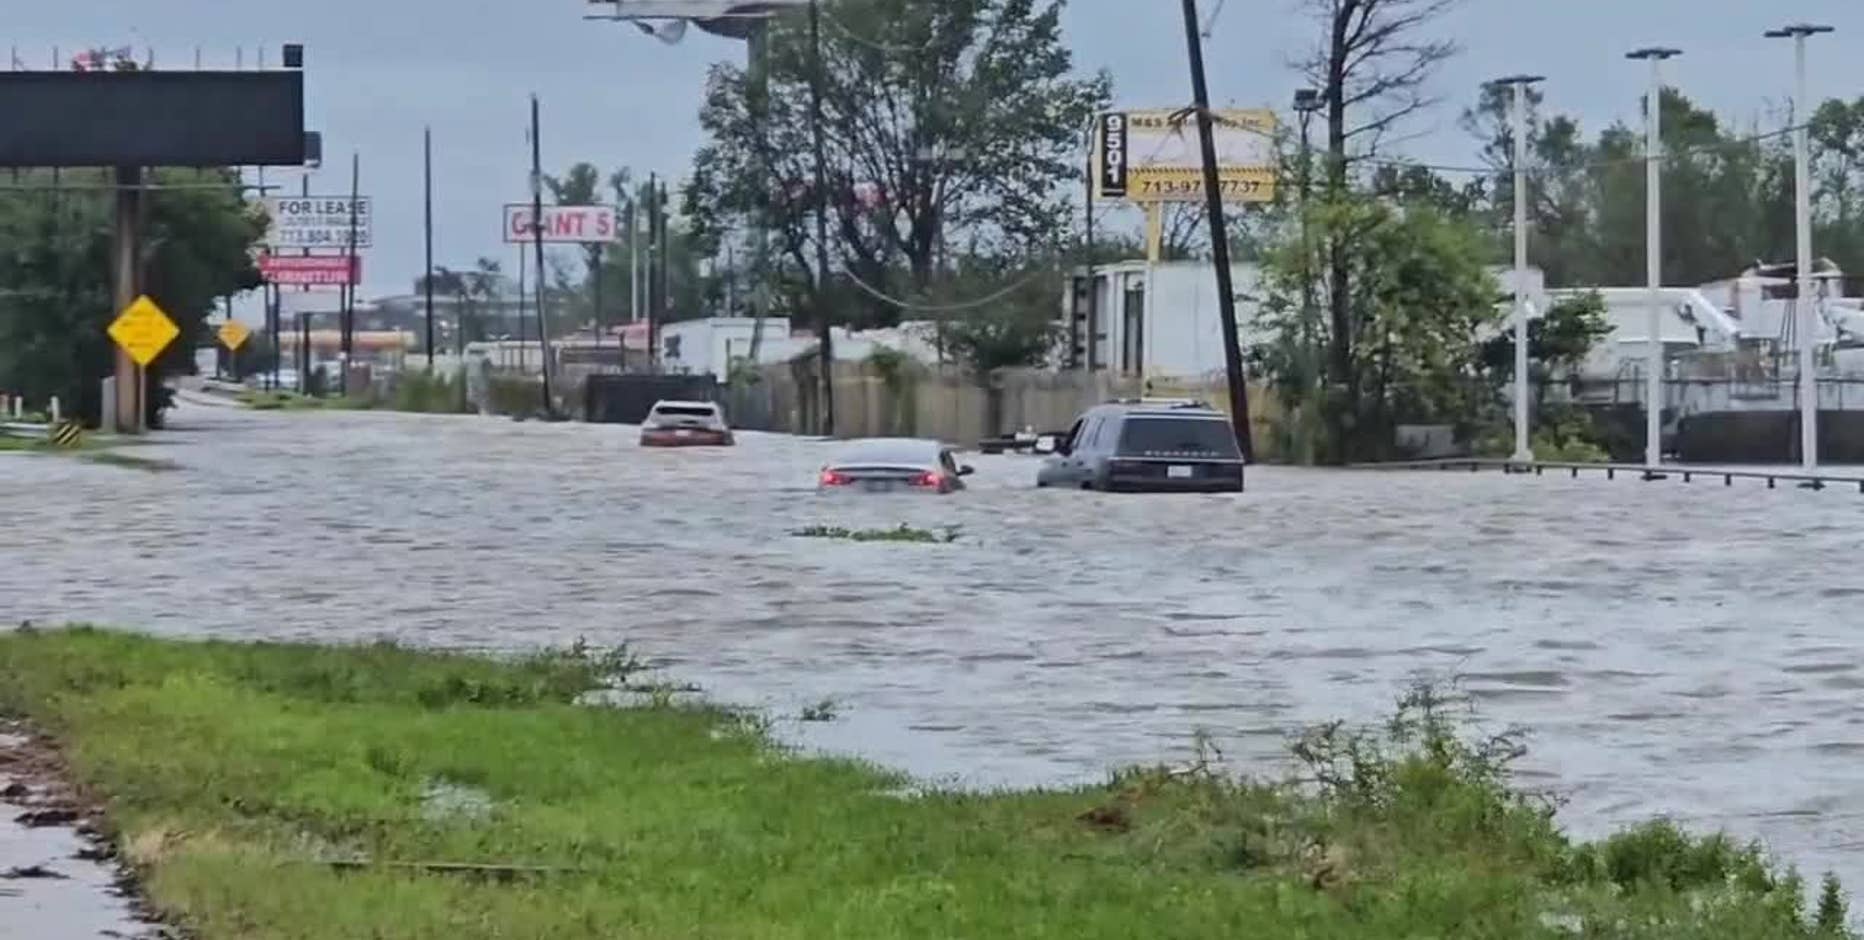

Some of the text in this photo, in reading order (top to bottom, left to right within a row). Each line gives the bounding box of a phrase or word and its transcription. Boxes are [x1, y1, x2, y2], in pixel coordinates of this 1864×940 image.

[1106, 115, 1121, 183] 9501
[1142, 180, 1260, 193] 713-977737
[279, 201, 311, 214] FOR
[512, 212, 585, 235] GANT
